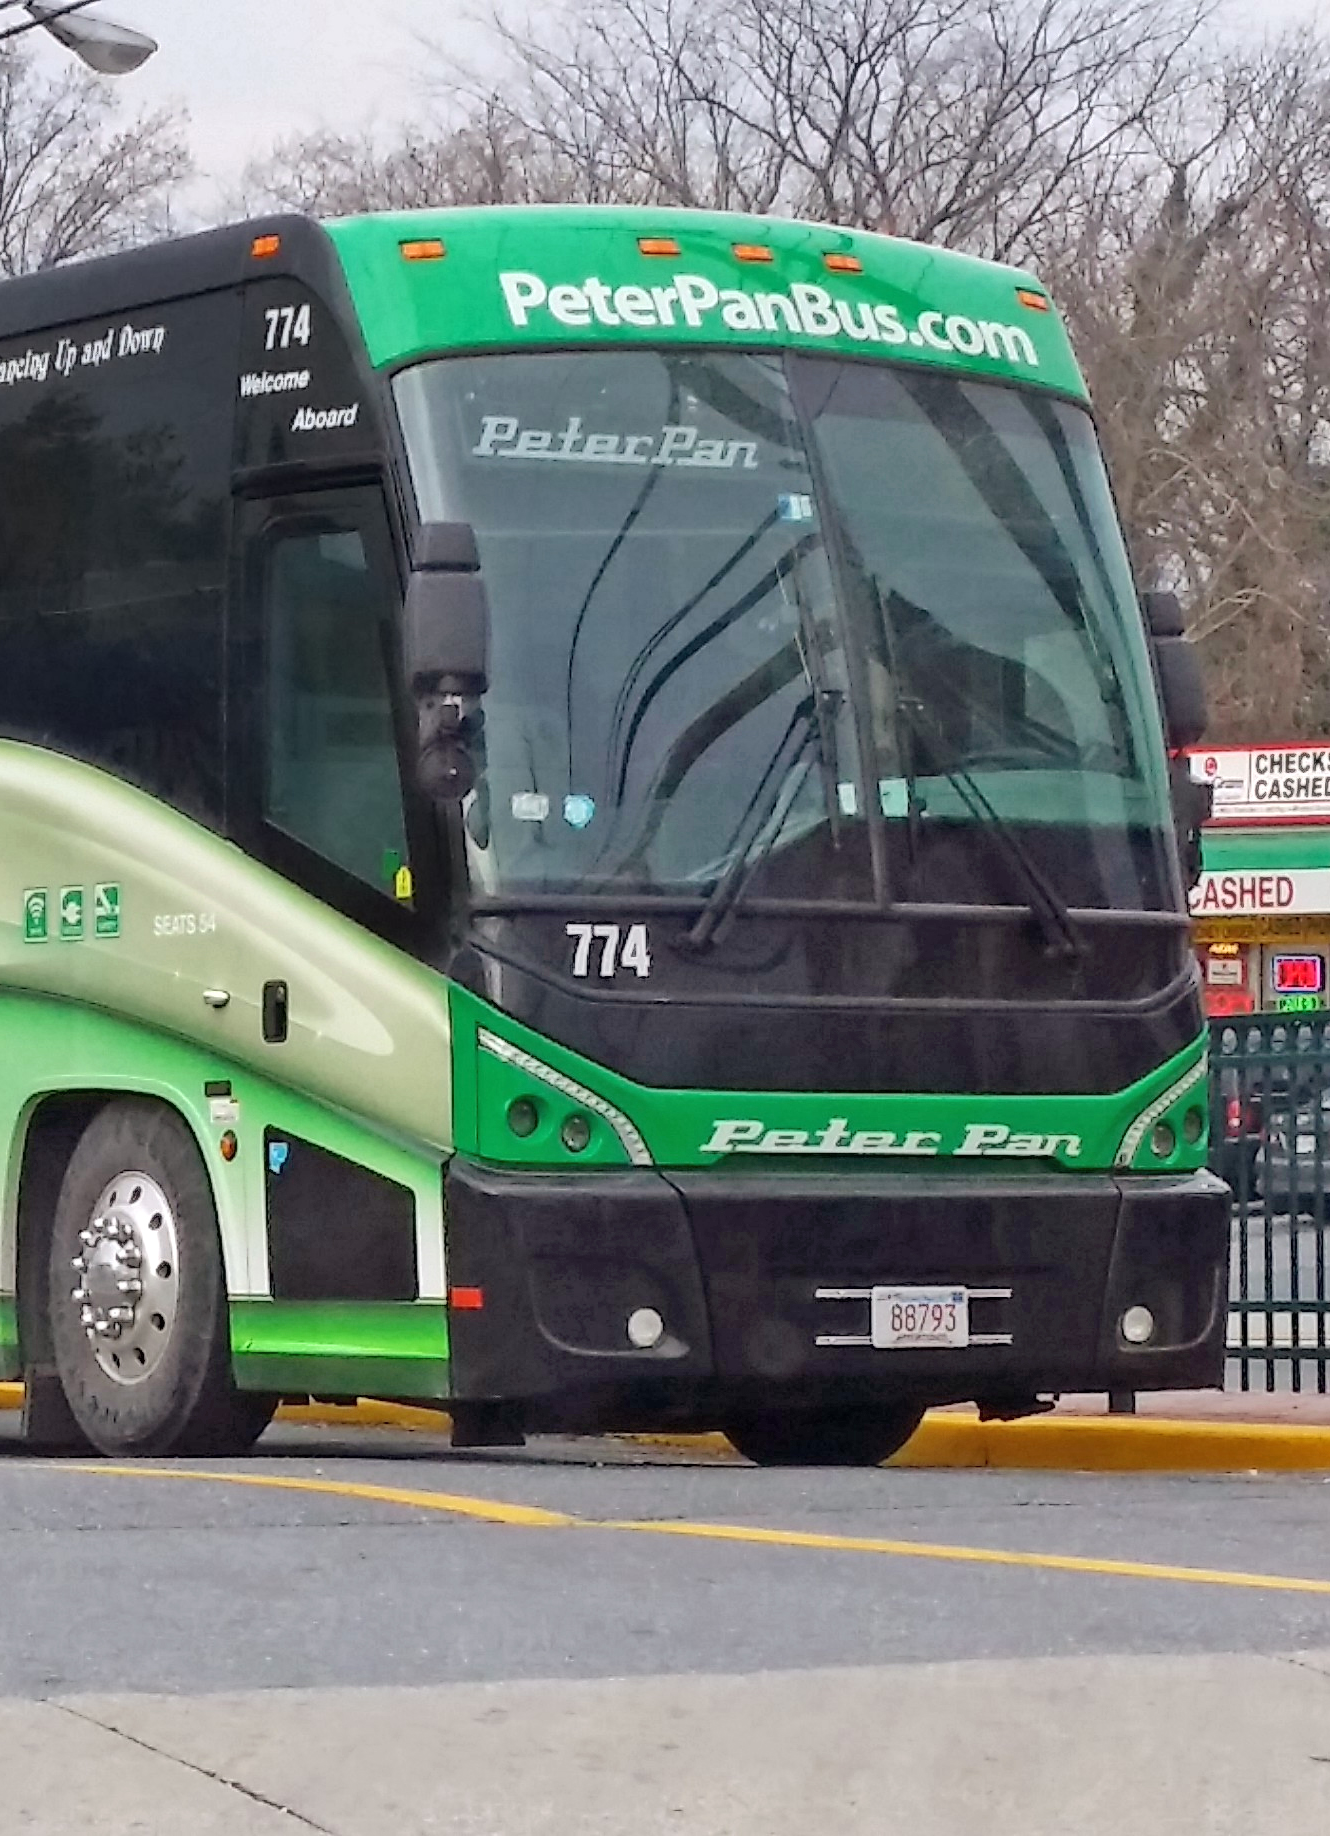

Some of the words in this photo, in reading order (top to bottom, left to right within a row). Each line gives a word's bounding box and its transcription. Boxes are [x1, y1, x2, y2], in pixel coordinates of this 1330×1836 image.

[264, 303, 311, 350] 774
[498, 272, 1038, 365] PeterPanBus.com
[55, 338, 77, 377] Up
[81, 328, 114, 367] and
[117, 324, 165, 357] Down
[240, 369, 311, 397] Welcome
[291, 402, 359, 431] Aboard
[473, 416, 655, 466] Peter
[655, 424, 759, 469] Pan
[153, 913, 196, 937] SEATS
[199, 912, 216, 935] 54
[566, 924, 651, 978] 774
[699, 1118, 942, 1156] Peter
[953, 1123, 1082, 1157] Pan
[891, 1304, 956, 1332] 88793
